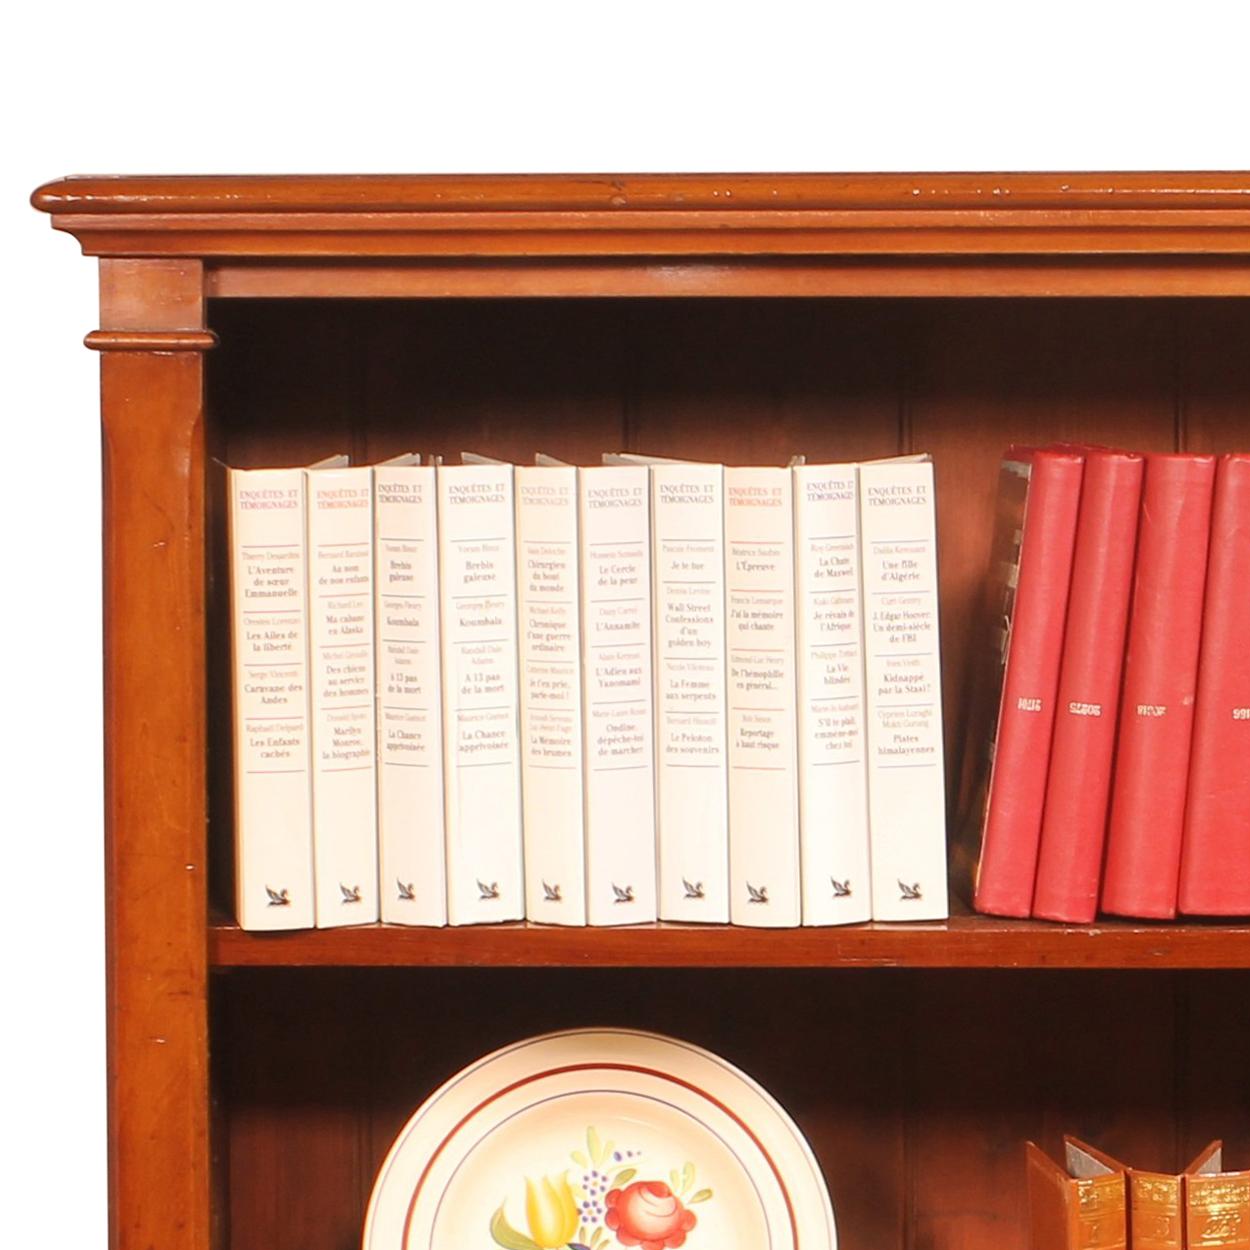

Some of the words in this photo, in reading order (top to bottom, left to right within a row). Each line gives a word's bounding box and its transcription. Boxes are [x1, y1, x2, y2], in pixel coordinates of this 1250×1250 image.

[244, 589, 298, 598] Emmanuelle
[250, 737, 265, 747] Les
[268, 737, 300, 747] Enfants
